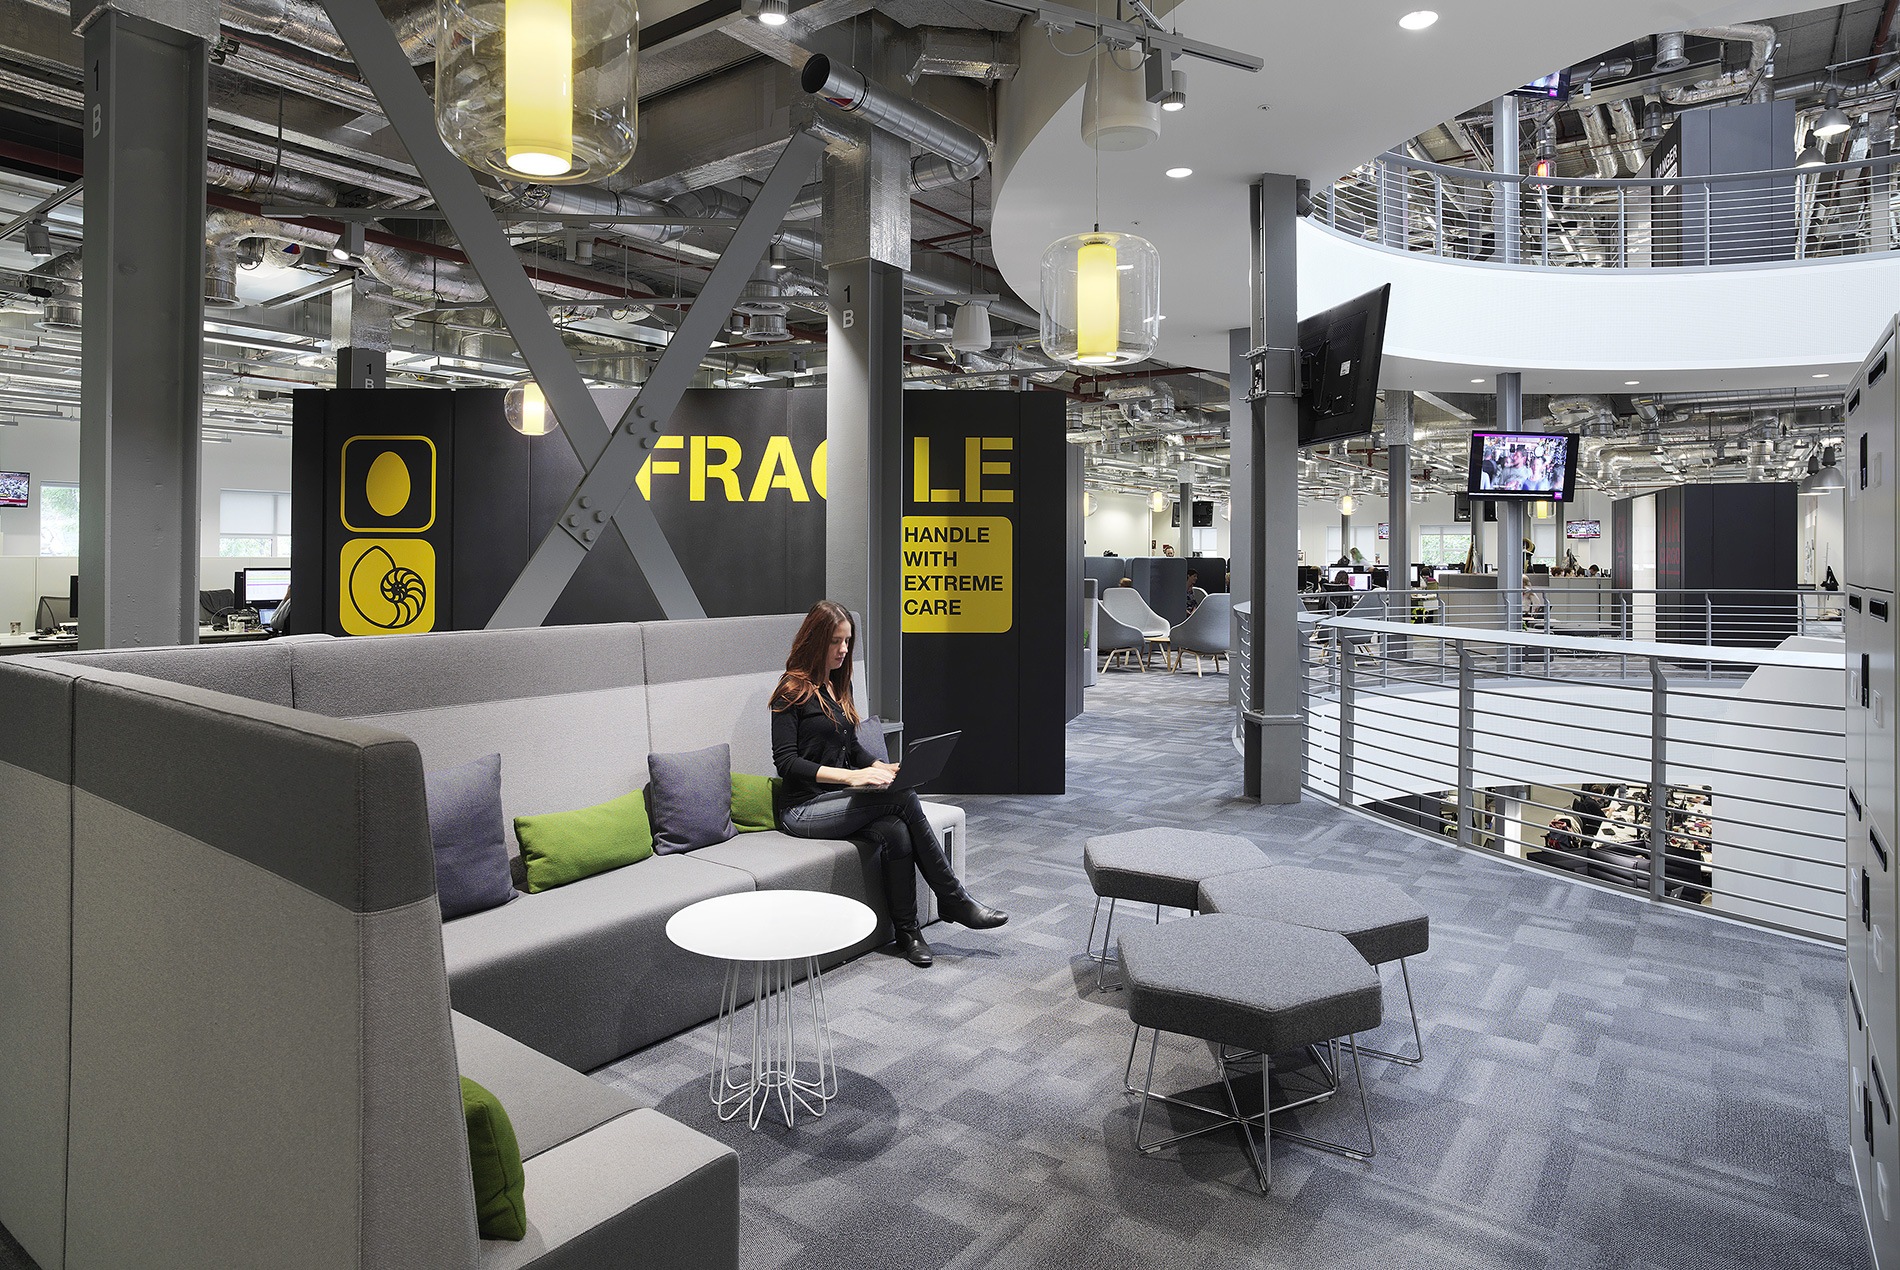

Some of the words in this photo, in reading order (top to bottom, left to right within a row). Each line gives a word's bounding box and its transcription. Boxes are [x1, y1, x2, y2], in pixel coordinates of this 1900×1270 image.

[93, 59, 99, 92] 1
[92, 103, 102, 139] B
[844, 285, 850, 303] 1
[842, 309, 855, 329] B
[366, 363, 372, 375] 1
[364, 378, 375, 389] B
[635, 435, 1014, 503] FRALE
[904, 526, 990, 543] HANDLE
[903, 550, 958, 567] WITH
[904, 575, 1004, 592] EXTREME
[903, 598, 962, 616] CARE
